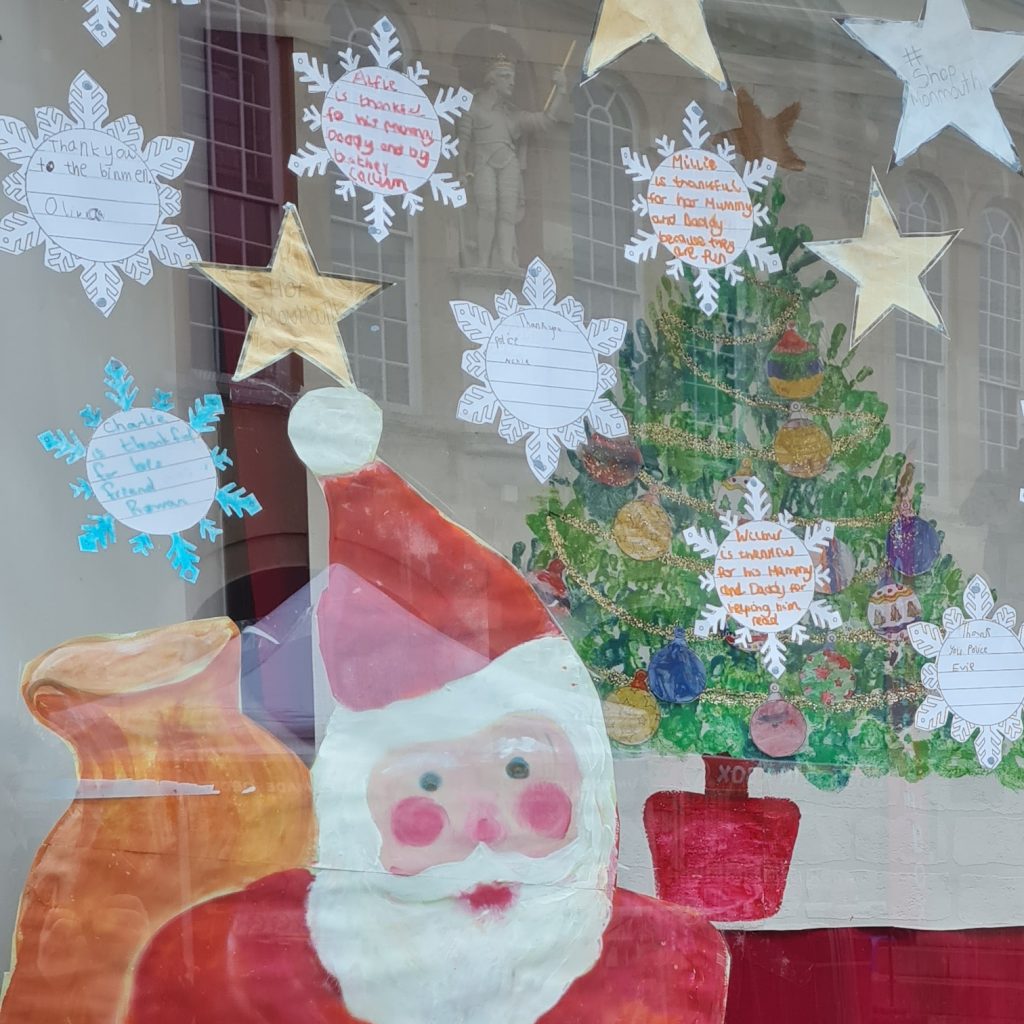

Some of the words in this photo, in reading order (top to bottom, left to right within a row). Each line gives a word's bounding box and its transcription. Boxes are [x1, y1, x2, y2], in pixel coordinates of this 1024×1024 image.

[50, 139, 99, 157] Thank
[37, 156, 55, 173] to
[64, 159, 88, 178] the
[655, 176, 666, 187] is
[648, 192, 667, 205] for
[651, 214, 676, 226] and
